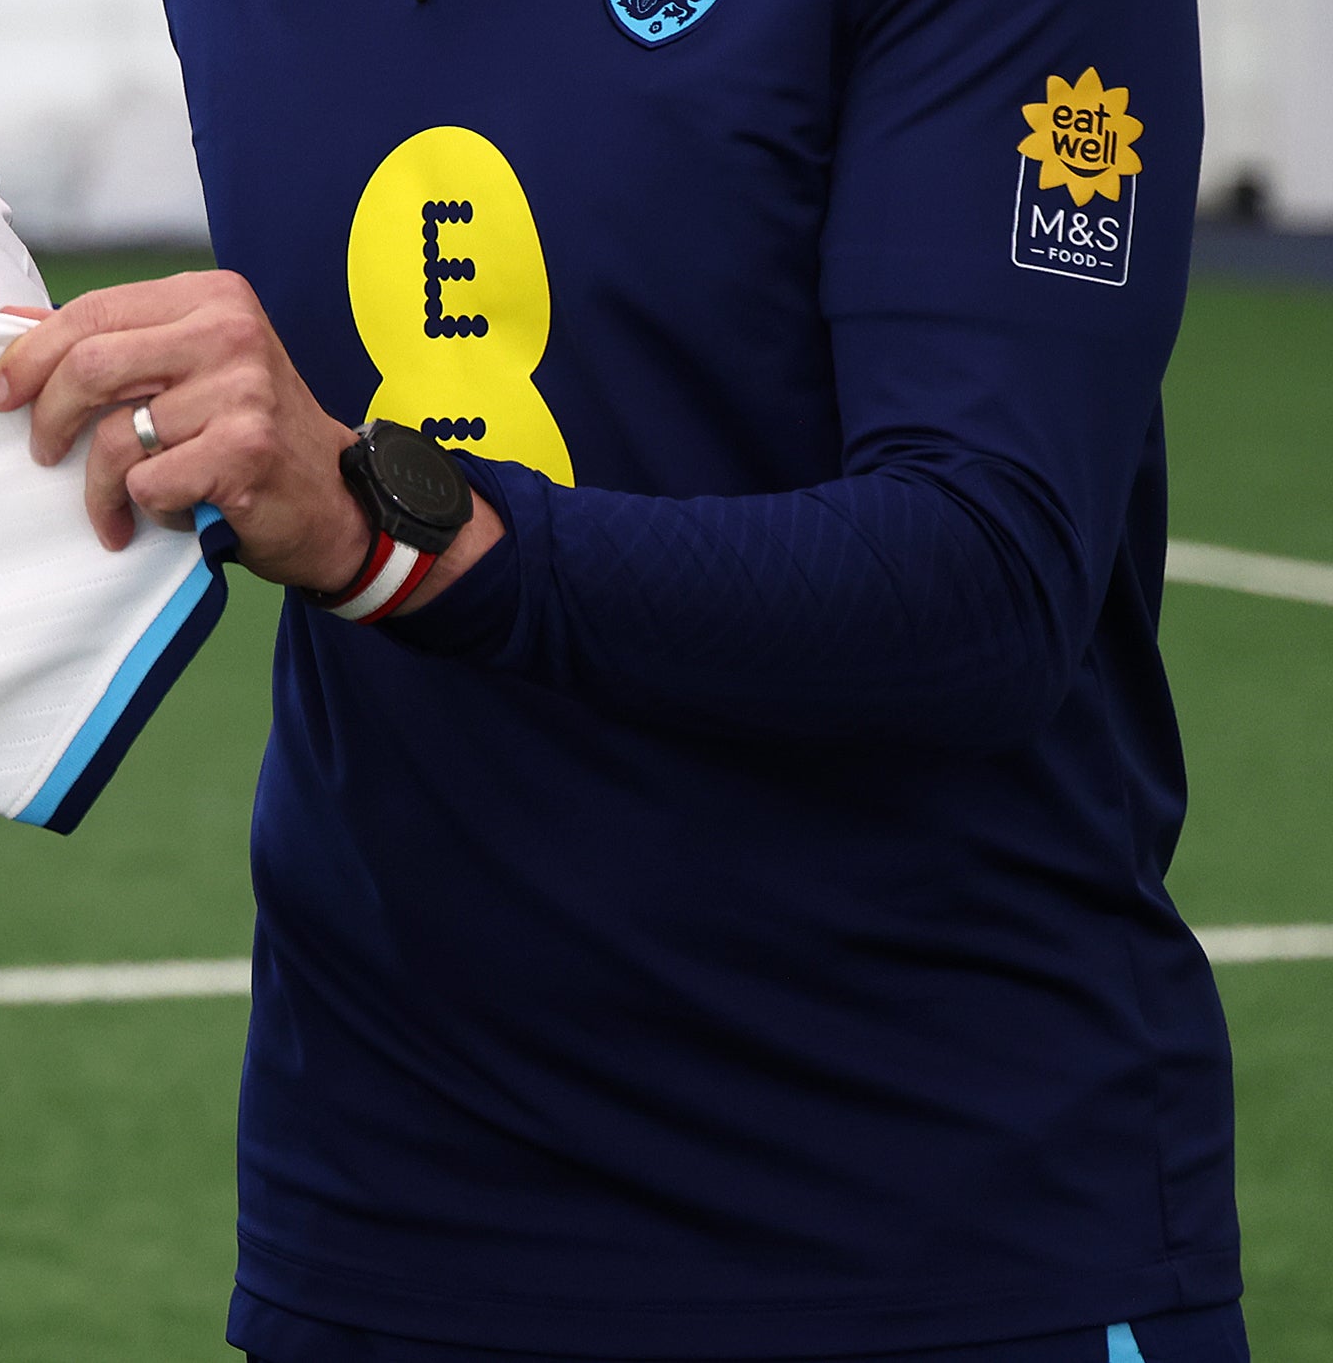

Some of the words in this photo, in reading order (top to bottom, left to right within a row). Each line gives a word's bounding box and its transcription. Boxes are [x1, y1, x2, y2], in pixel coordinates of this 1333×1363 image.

[1052, 103, 1111, 137] eat
[1051, 129, 1118, 166] well
[1030, 204, 1121, 252] M&S
[1048, 247, 1098, 268] FOOD
